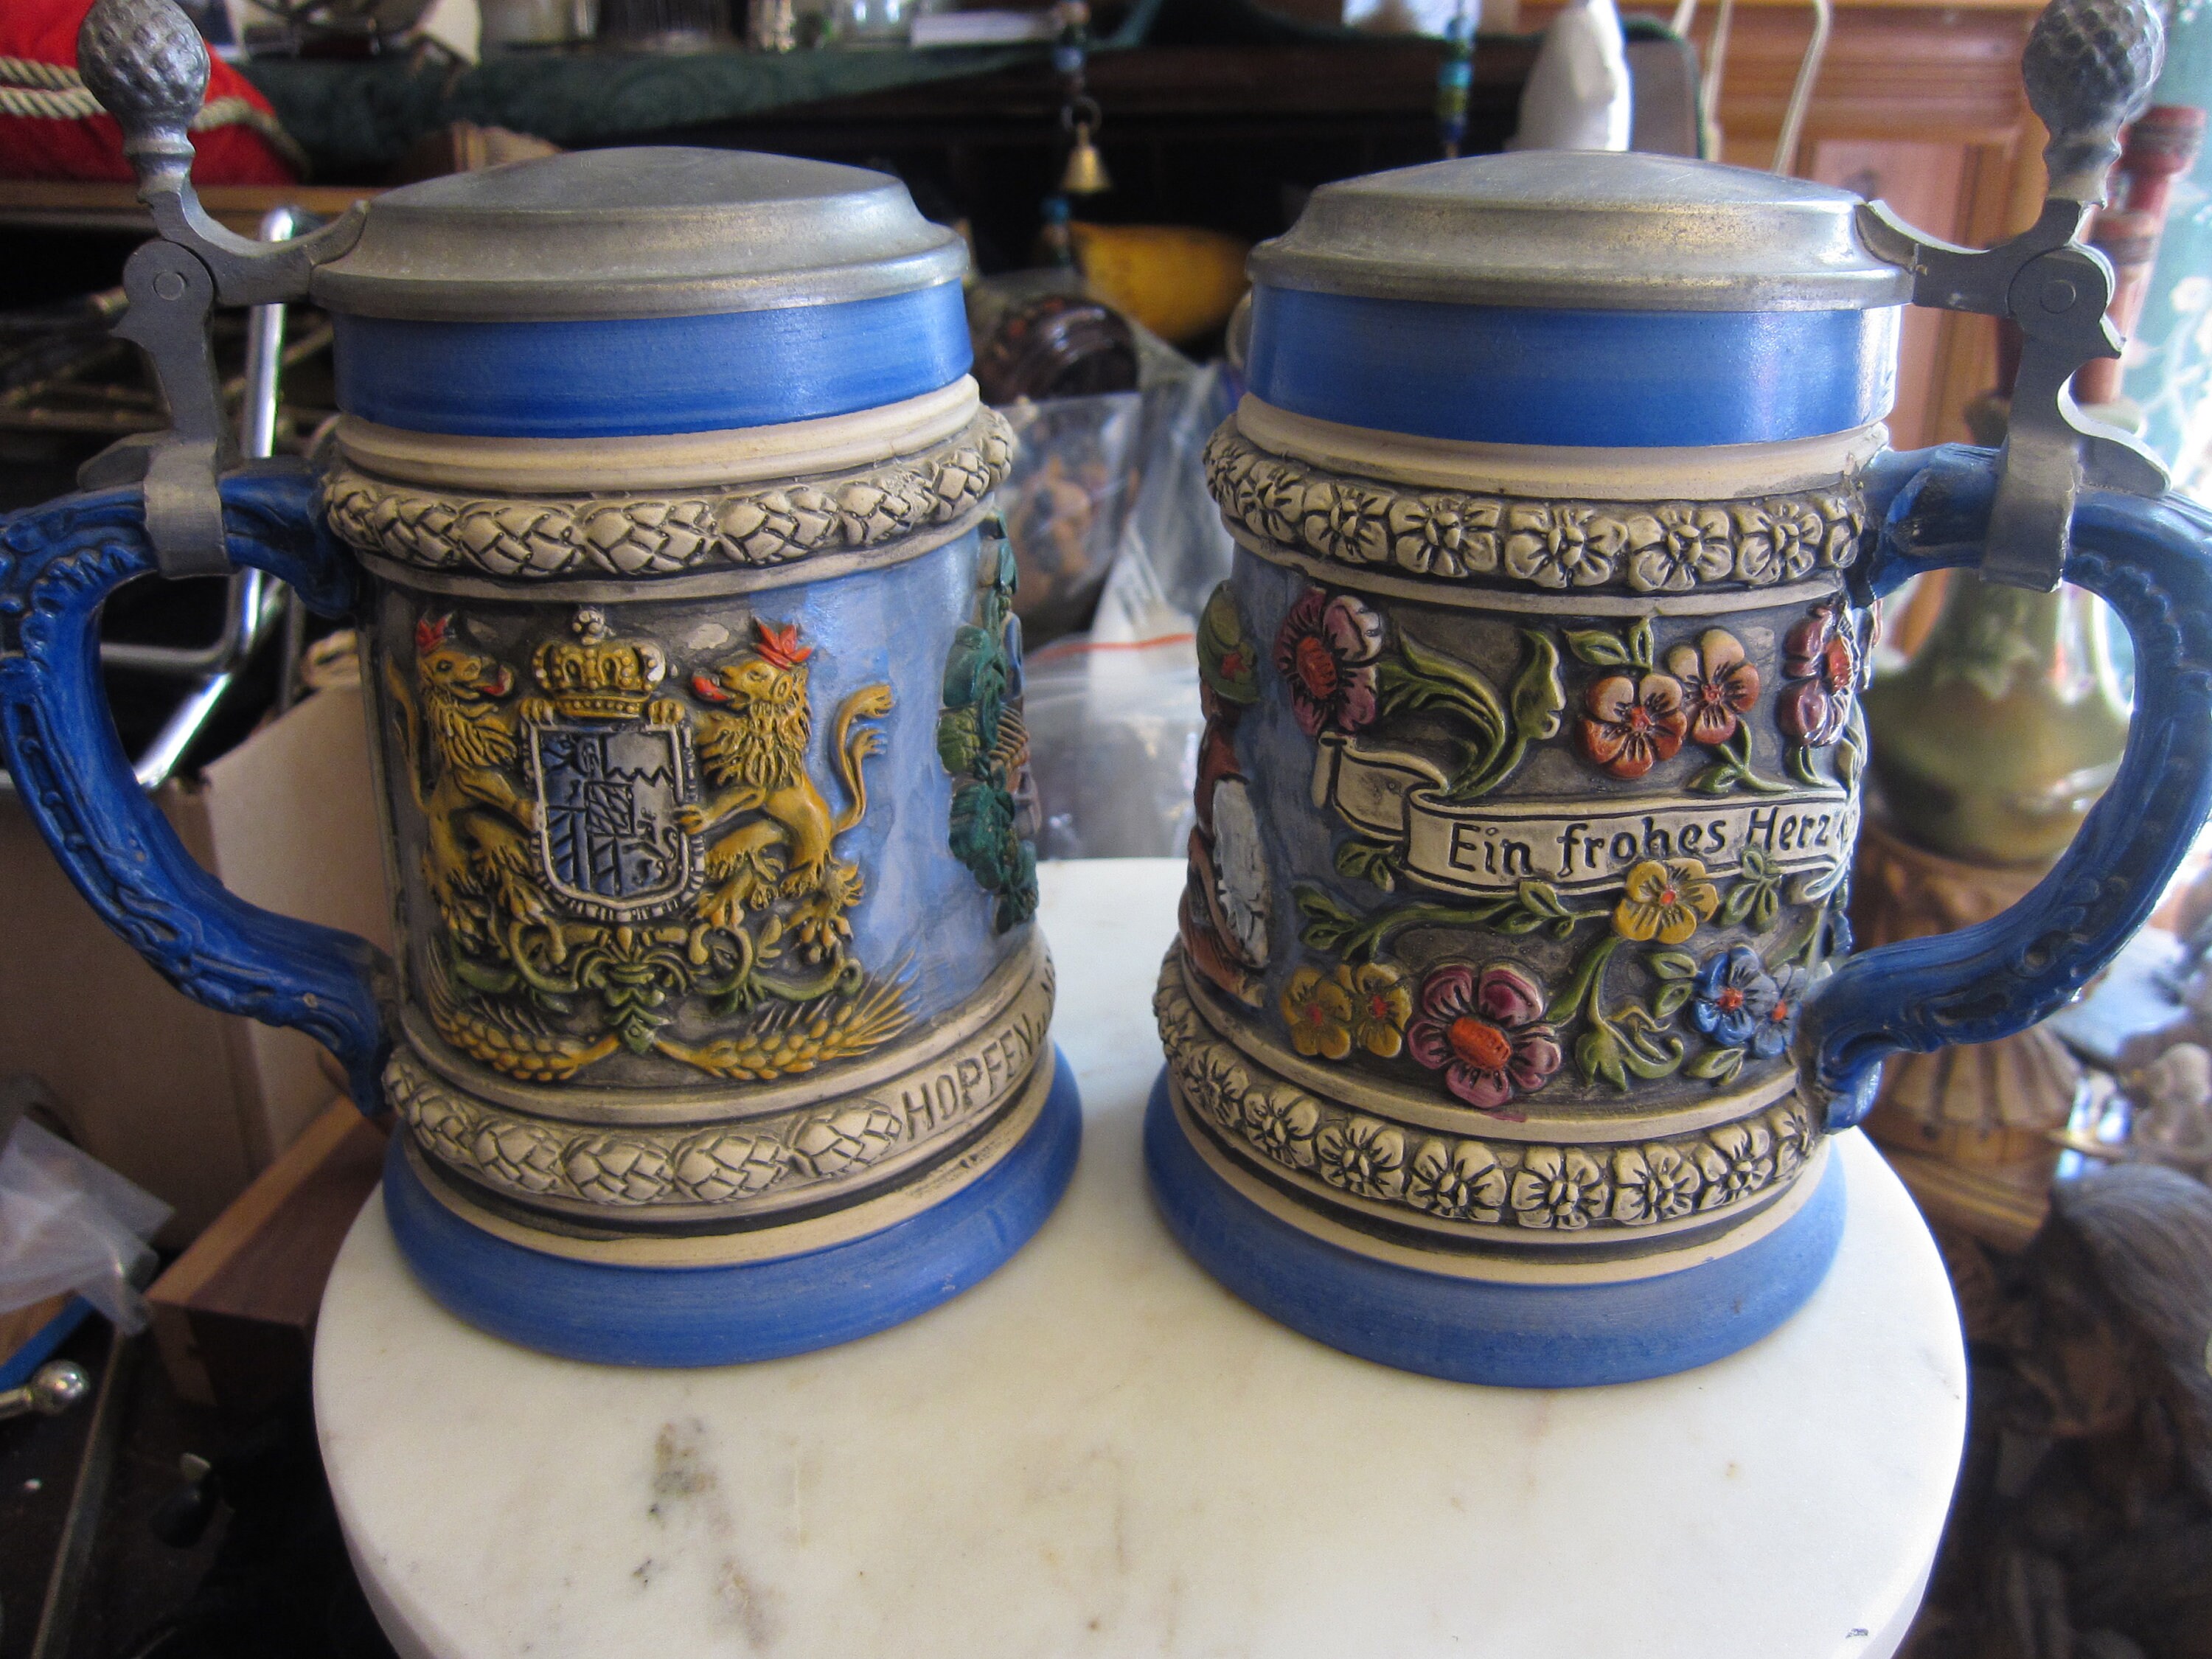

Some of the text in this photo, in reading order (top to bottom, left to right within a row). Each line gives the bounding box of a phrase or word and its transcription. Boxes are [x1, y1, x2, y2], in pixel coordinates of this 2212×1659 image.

[1447, 821, 1533, 876] Ein
[1556, 815, 1727, 877] frohes
[1746, 805, 1831, 851] Herz
